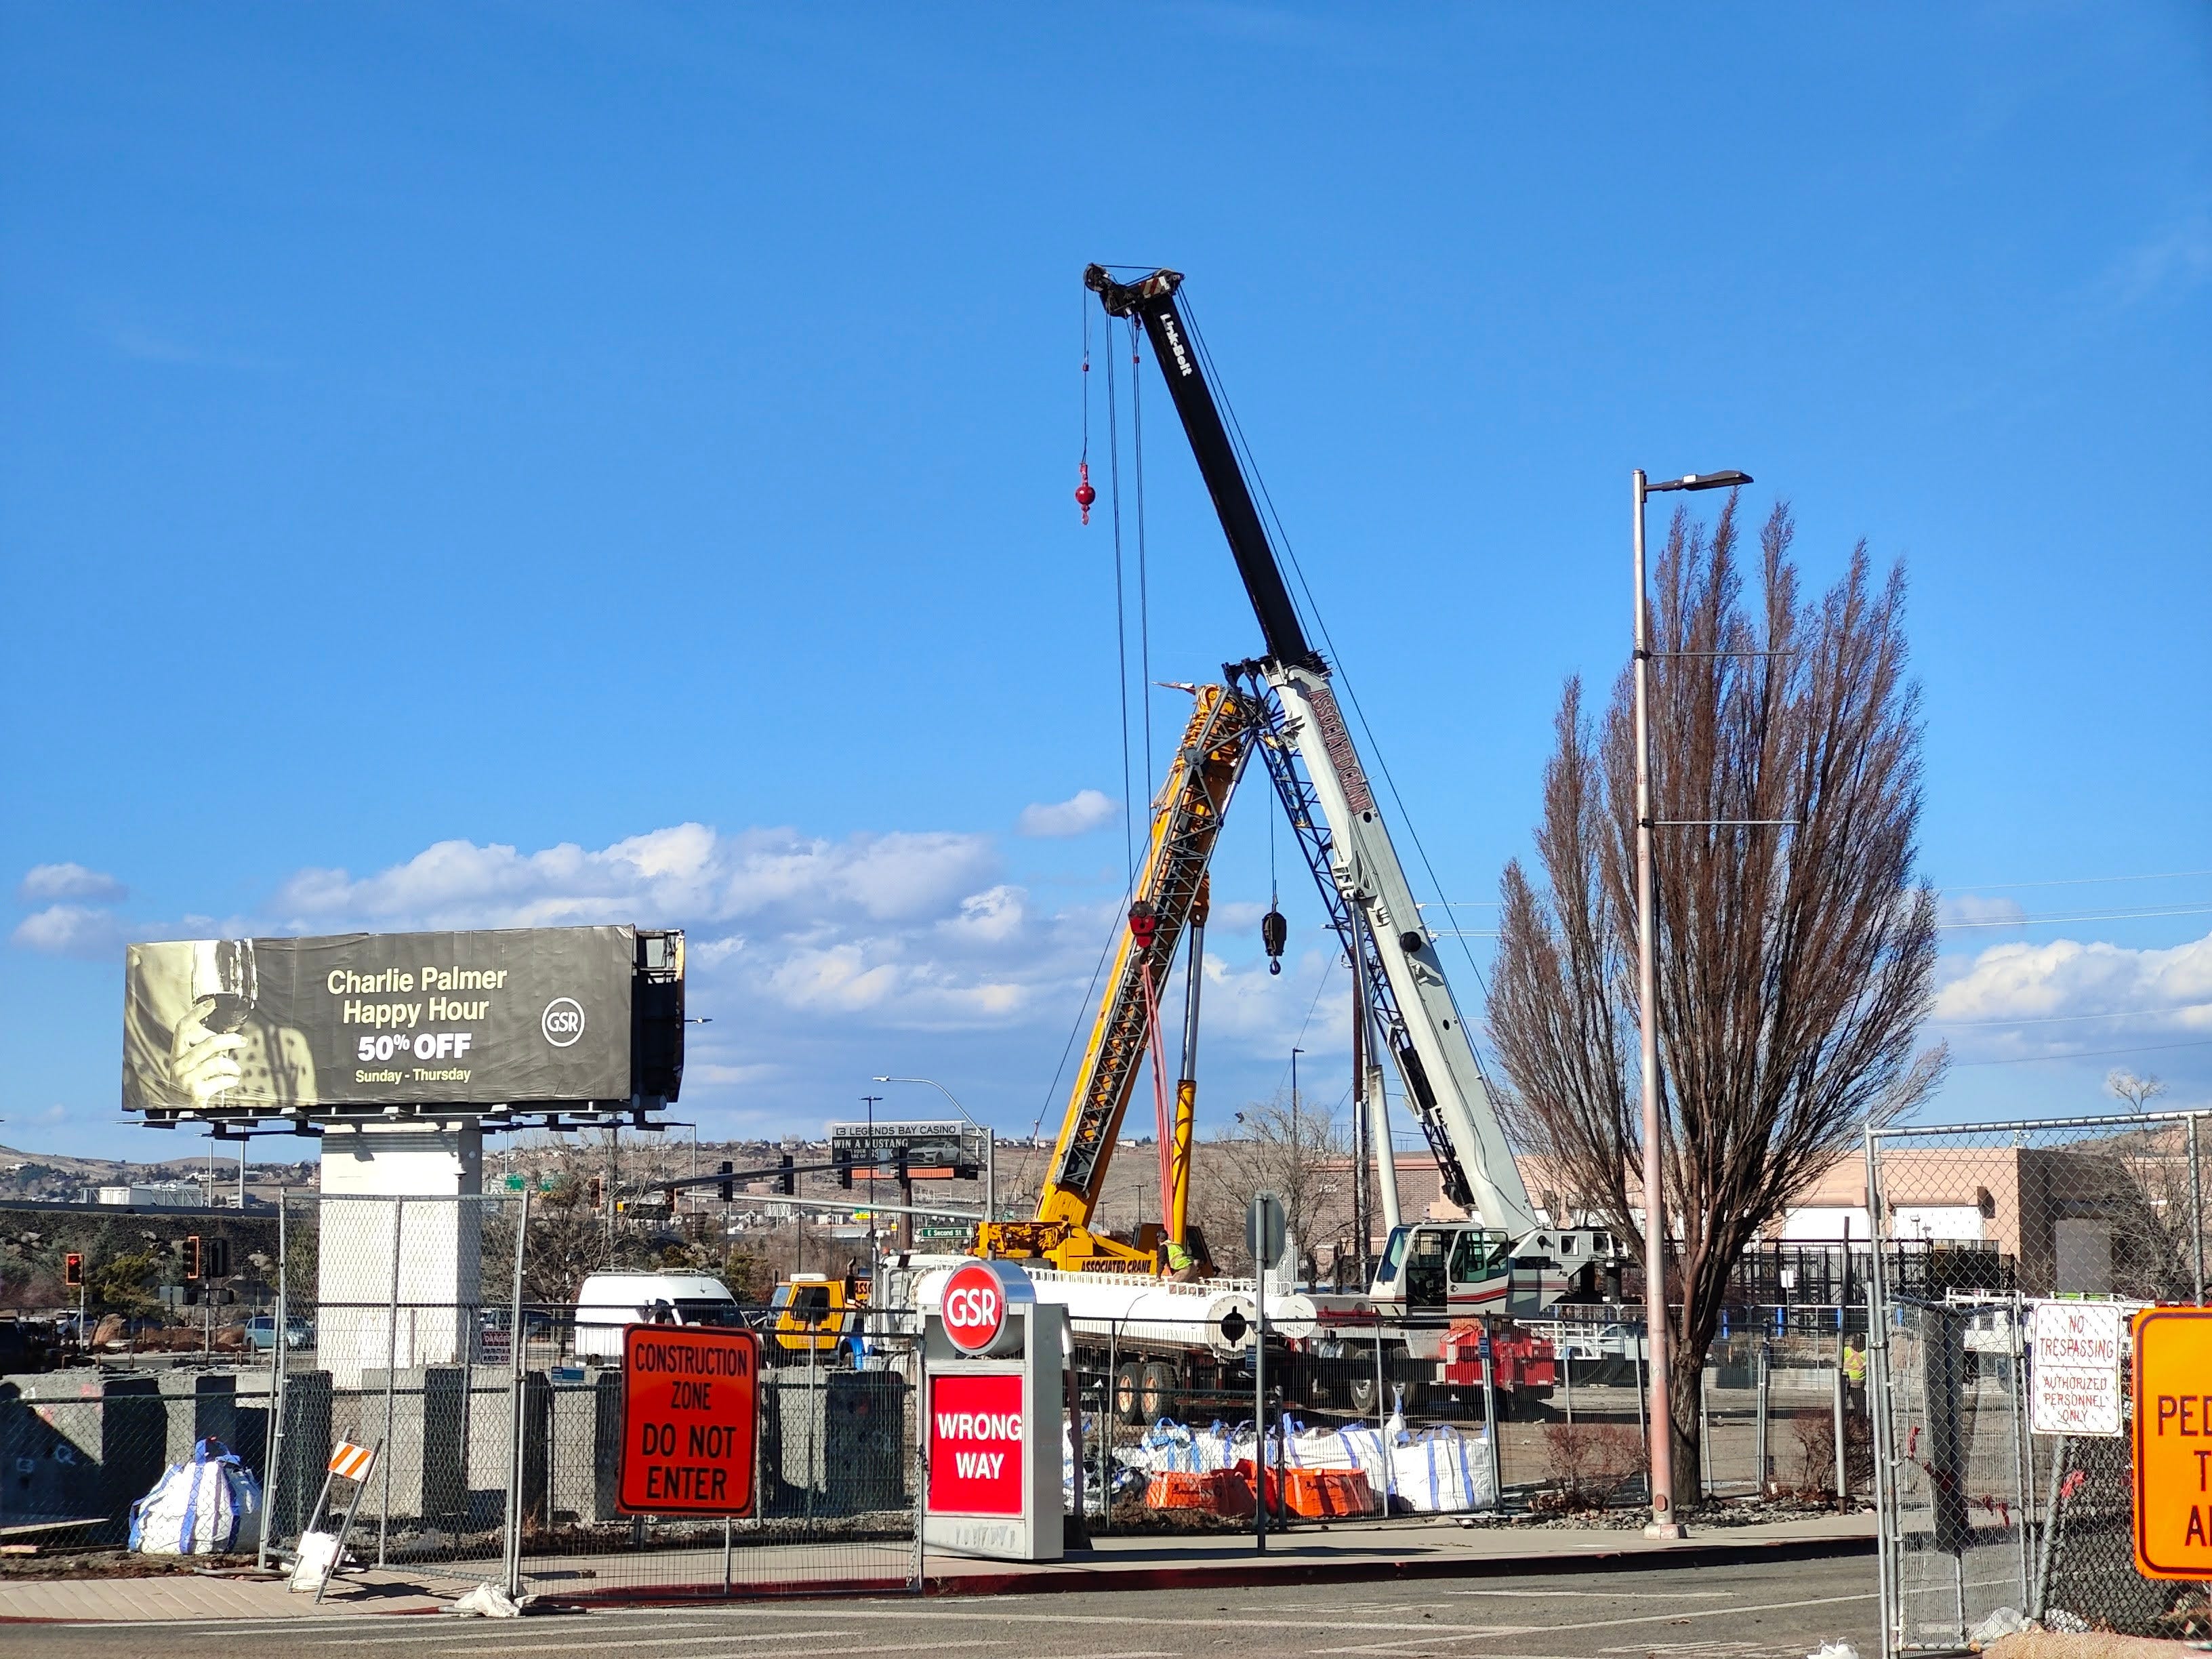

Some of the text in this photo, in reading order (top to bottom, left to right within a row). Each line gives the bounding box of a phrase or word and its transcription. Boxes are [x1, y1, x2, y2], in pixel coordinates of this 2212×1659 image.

[1308, 689, 1373, 815] ASSOCIATED CRANE
[327, 966, 508, 994] Charlie Palmer
[343, 996, 489, 1029] Happy Hour
[547, 1011, 578, 1032] GSR
[357, 1033, 472, 1061] 50% OFF
[355, 1069, 403, 1084] Sunday
[413, 1067, 471, 1083] Thursday
[833, 1139, 851, 1149] WIN
[855, 1139, 861, 1149] A
[865, 1139, 908, 1149] MUSTANG
[850, 1126, 895, 1135] LEGENDS
[898, 1126, 916, 1134] BAY
[920, 1126, 956, 1134] CASINO
[1081, 1260, 1151, 1273] ASSOCIATED CRANE
[947, 1288, 996, 1327] GSR
[2069, 1315, 2084, 1333] NO
[635, 1343, 747, 1377] CONSTRUCTION
[2040, 1338, 2113, 1358] TRESPASSING
[671, 1380, 712, 1410] ZONE
[2044, 1376, 2107, 1390] AUTHORIZED
[2043, 1393, 2106, 1407] PERSONNEL
[938, 1413, 1023, 1441] WRONG
[2062, 1410, 2088, 1422] ONLY
[642, 1422, 737, 1458] DO NOT
[956, 1452, 1004, 1479] WAY
[647, 1465, 727, 1500] ENTER
[2185, 1504, 2212, 1547] A
